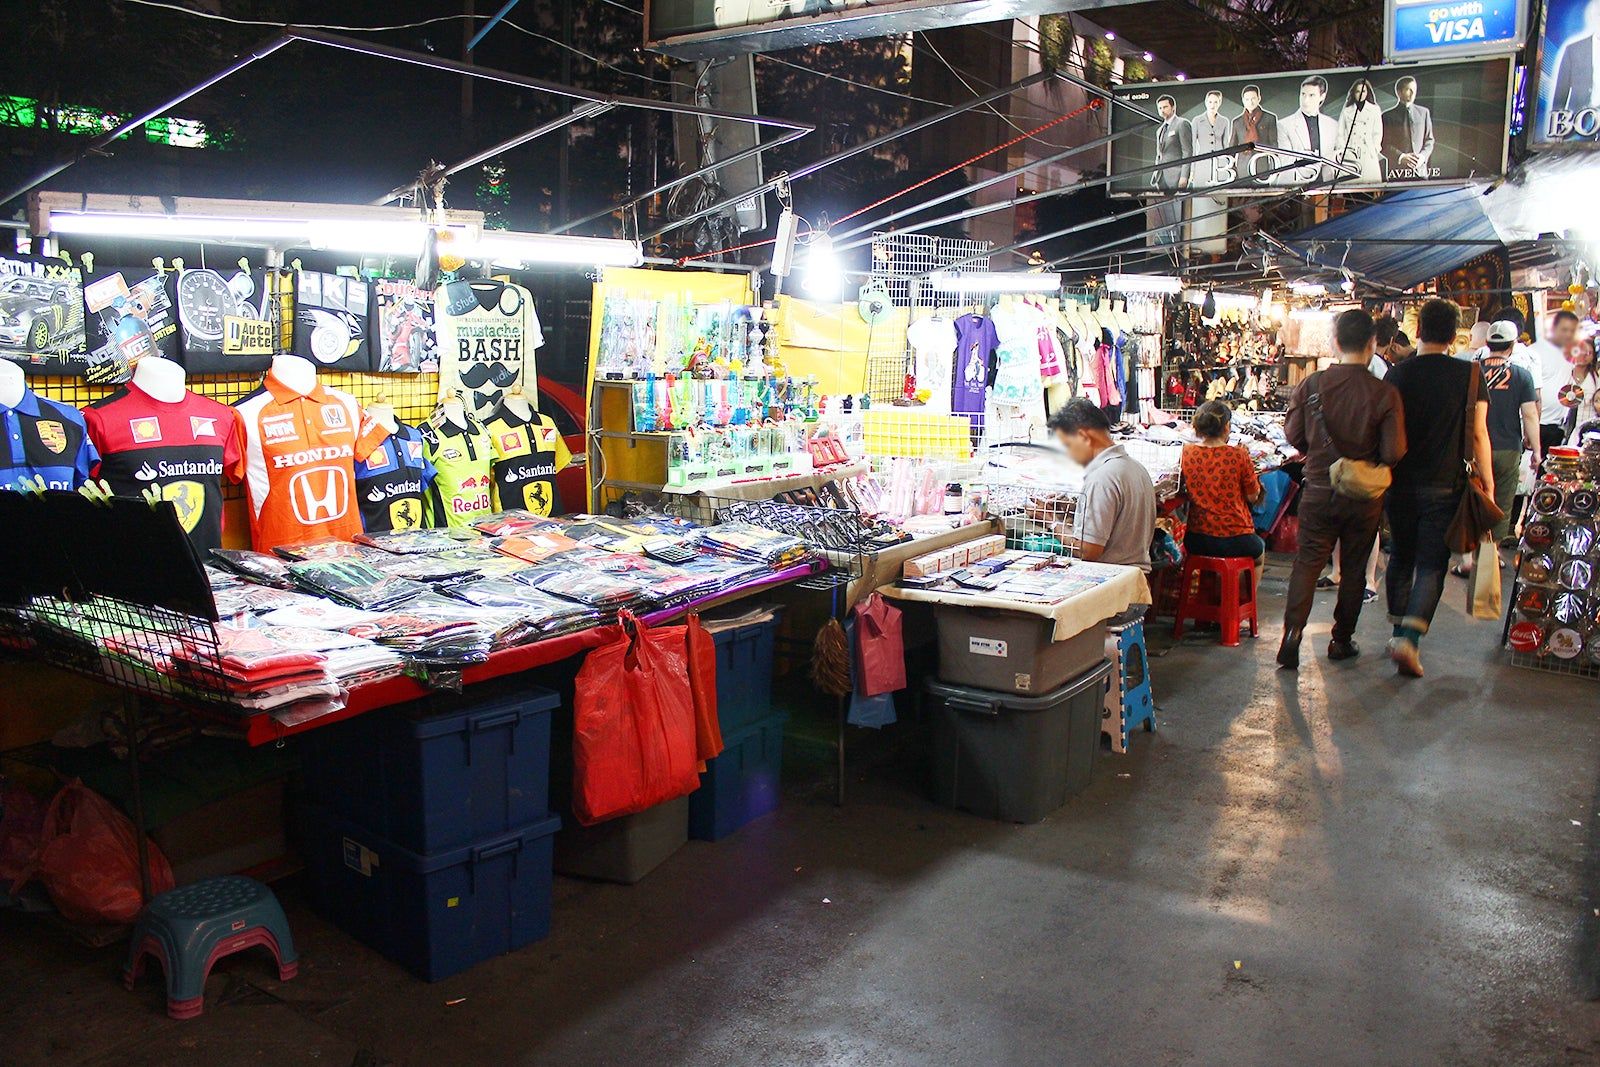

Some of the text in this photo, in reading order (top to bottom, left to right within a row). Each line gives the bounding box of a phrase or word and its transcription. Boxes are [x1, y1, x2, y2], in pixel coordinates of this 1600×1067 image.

[1429, 1, 1483, 21] go with
[1425, 17, 1485, 43] VISA
[1388, 167, 1441, 179] AVENUE
[298, 270, 368, 305] HKS
[242, 322, 271, 336] Auto
[456, 323, 520, 337] mustache
[241, 335, 273, 348] Mete
[458, 338, 521, 361] BASH
[273, 444, 354, 469] HONDA
[158, 458, 223, 478] Santander
